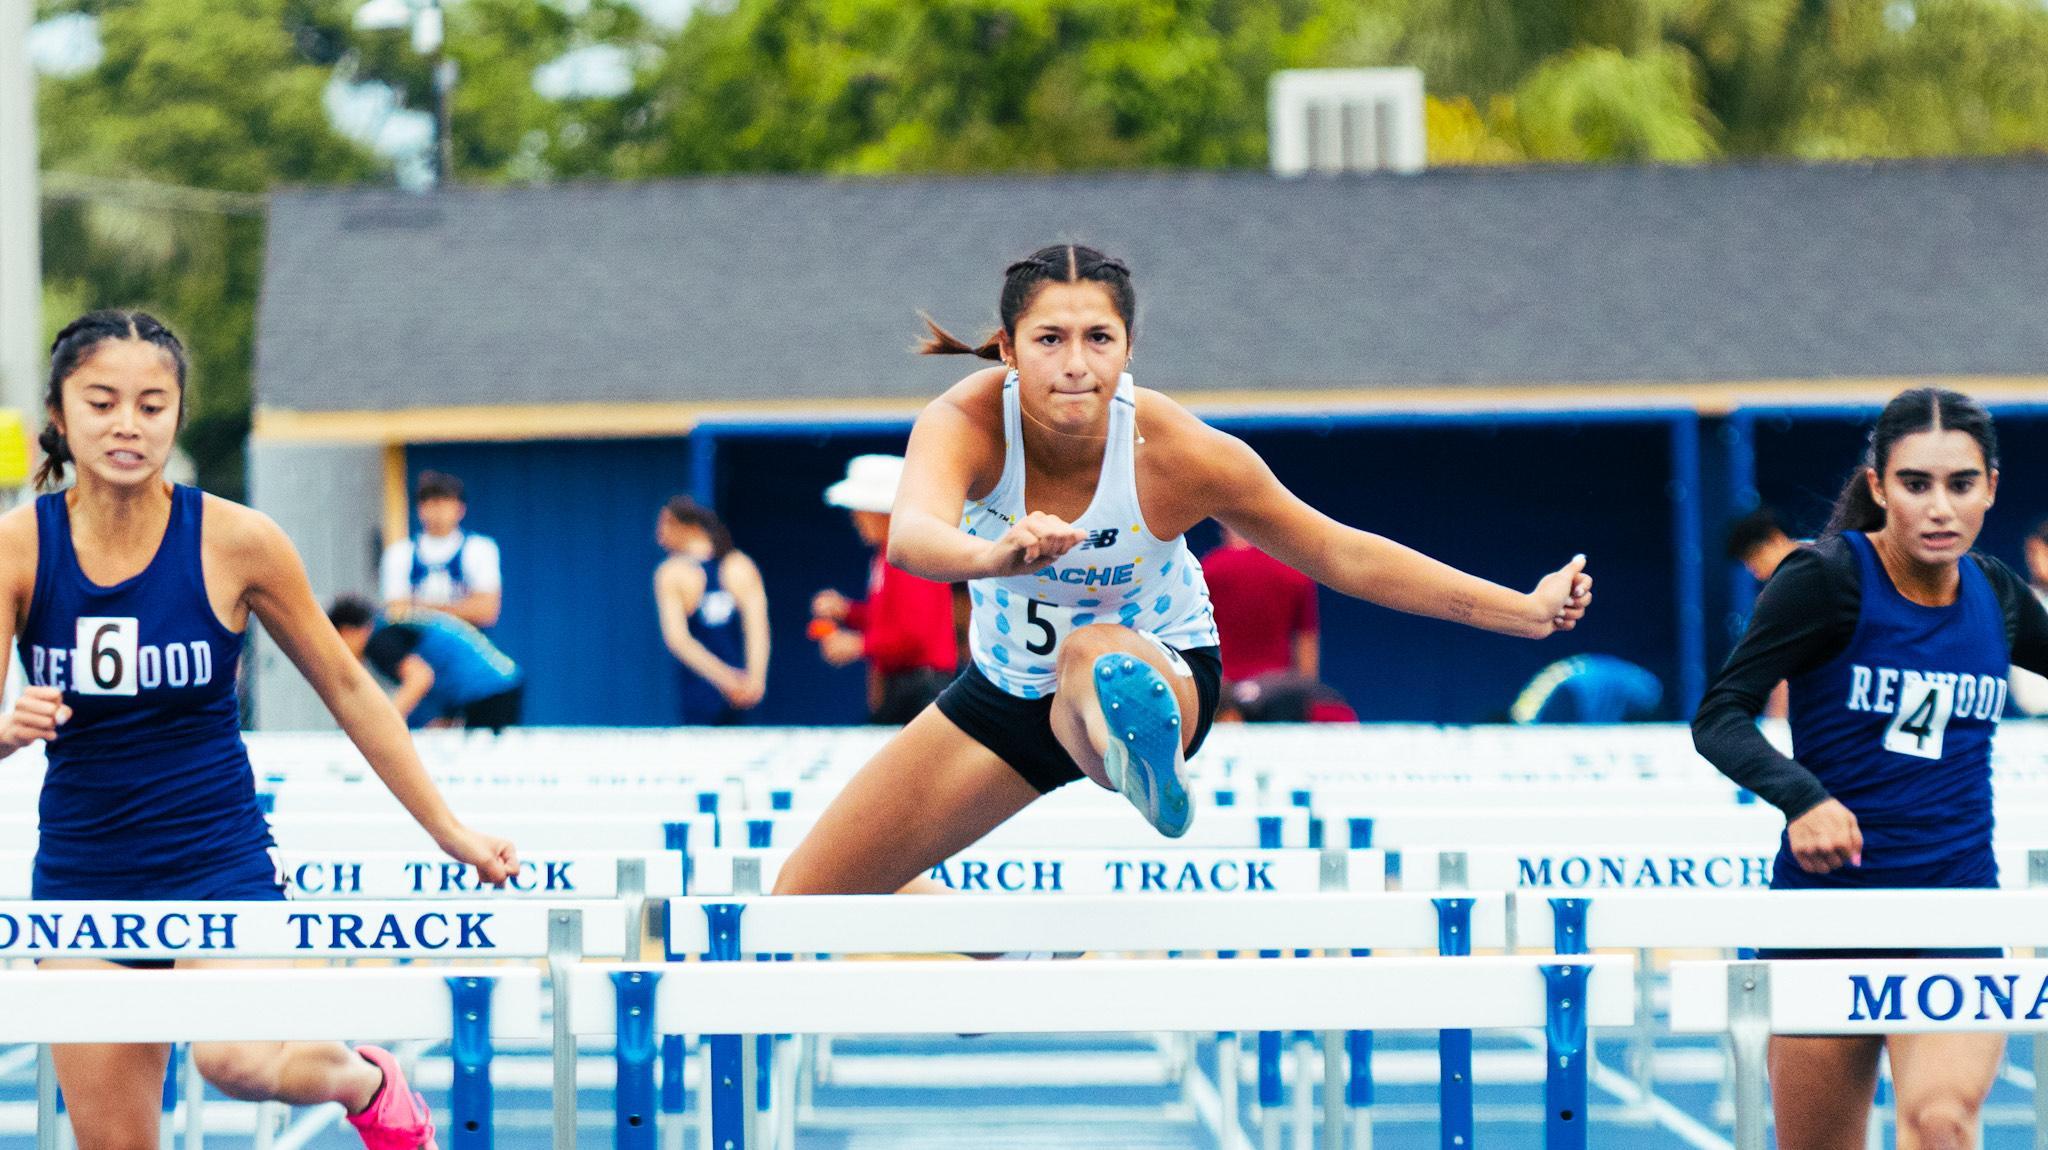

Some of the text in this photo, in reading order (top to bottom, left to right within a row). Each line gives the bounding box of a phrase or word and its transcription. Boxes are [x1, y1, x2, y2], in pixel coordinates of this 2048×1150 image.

[1026, 599, 1059, 656] 5
[32, 641, 212, 691] REOOD
[91, 623, 123, 689] 6
[1900, 688, 1938, 750] 4
[404, 861, 576, 893] TRCK
[1104, 861, 1276, 891] TRACK
[1517, 857, 1773, 888] MONARCH
[287, 912, 496, 949] TRACK
